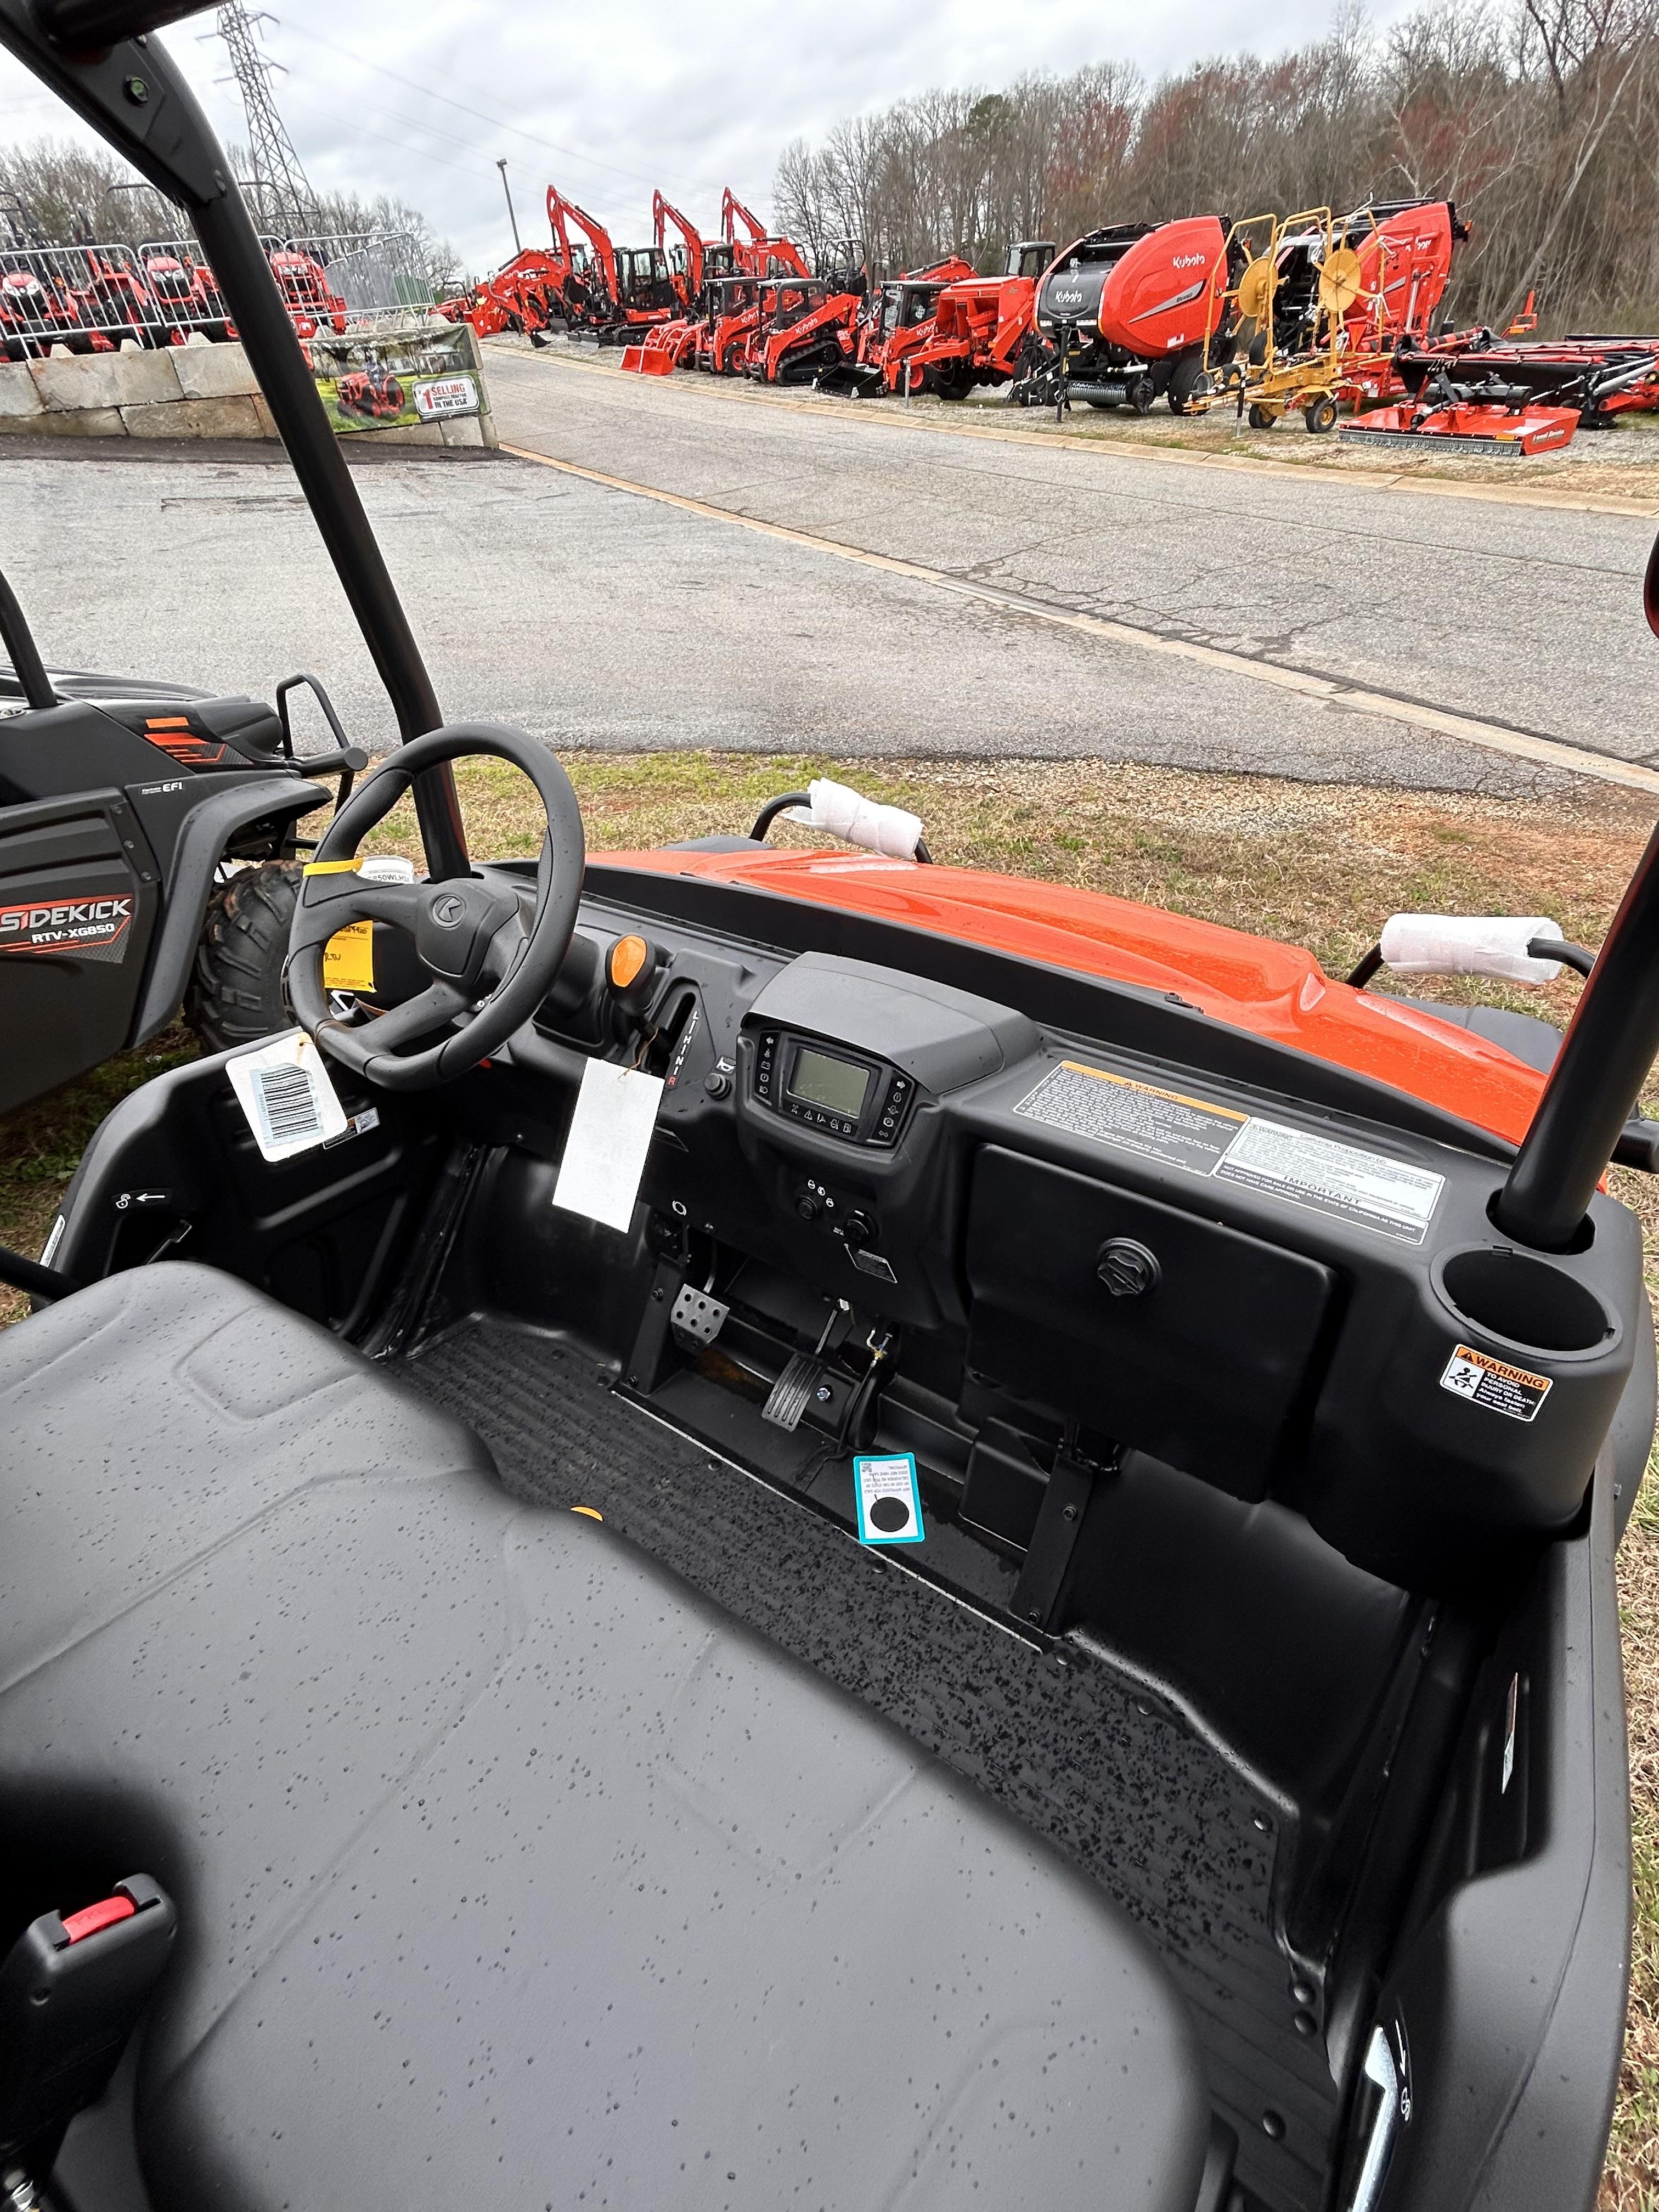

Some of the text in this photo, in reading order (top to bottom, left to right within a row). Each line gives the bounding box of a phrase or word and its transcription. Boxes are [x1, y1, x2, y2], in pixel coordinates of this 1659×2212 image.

[1173, 252, 1205, 269] Kubota
[1055, 290, 1083, 303] Kubota
[795, 317, 819, 334] Kubota
[431, 383, 465, 396] SELLING
[162, 782, 182, 792] EFI
[0, 899, 131, 932] SIDEKICK
[32, 923, 115, 944] RTV-XG850
[1135, 1083, 1178, 1101] WARNING
[1334, 1144, 1375, 1160] Proposition
[1234, 1169, 1261, 1180] APPROVED
[1323, 1198, 1340, 1206] STATE
[1348, 1206, 1380, 1221] CALIFORNIA
[1284, 1176, 1362, 1204] IMPORTANT
[1476, 1356, 1545, 1388] WARNING
[1481, 1382, 1503, 1393] INJURY
[1483, 1376, 1522, 1396] PERSONAL
[1497, 1376, 1520, 1388] AVOID
[1479, 1387, 1525, 1409] Always fasten
[1492, 1400, 1508, 1408] seat
